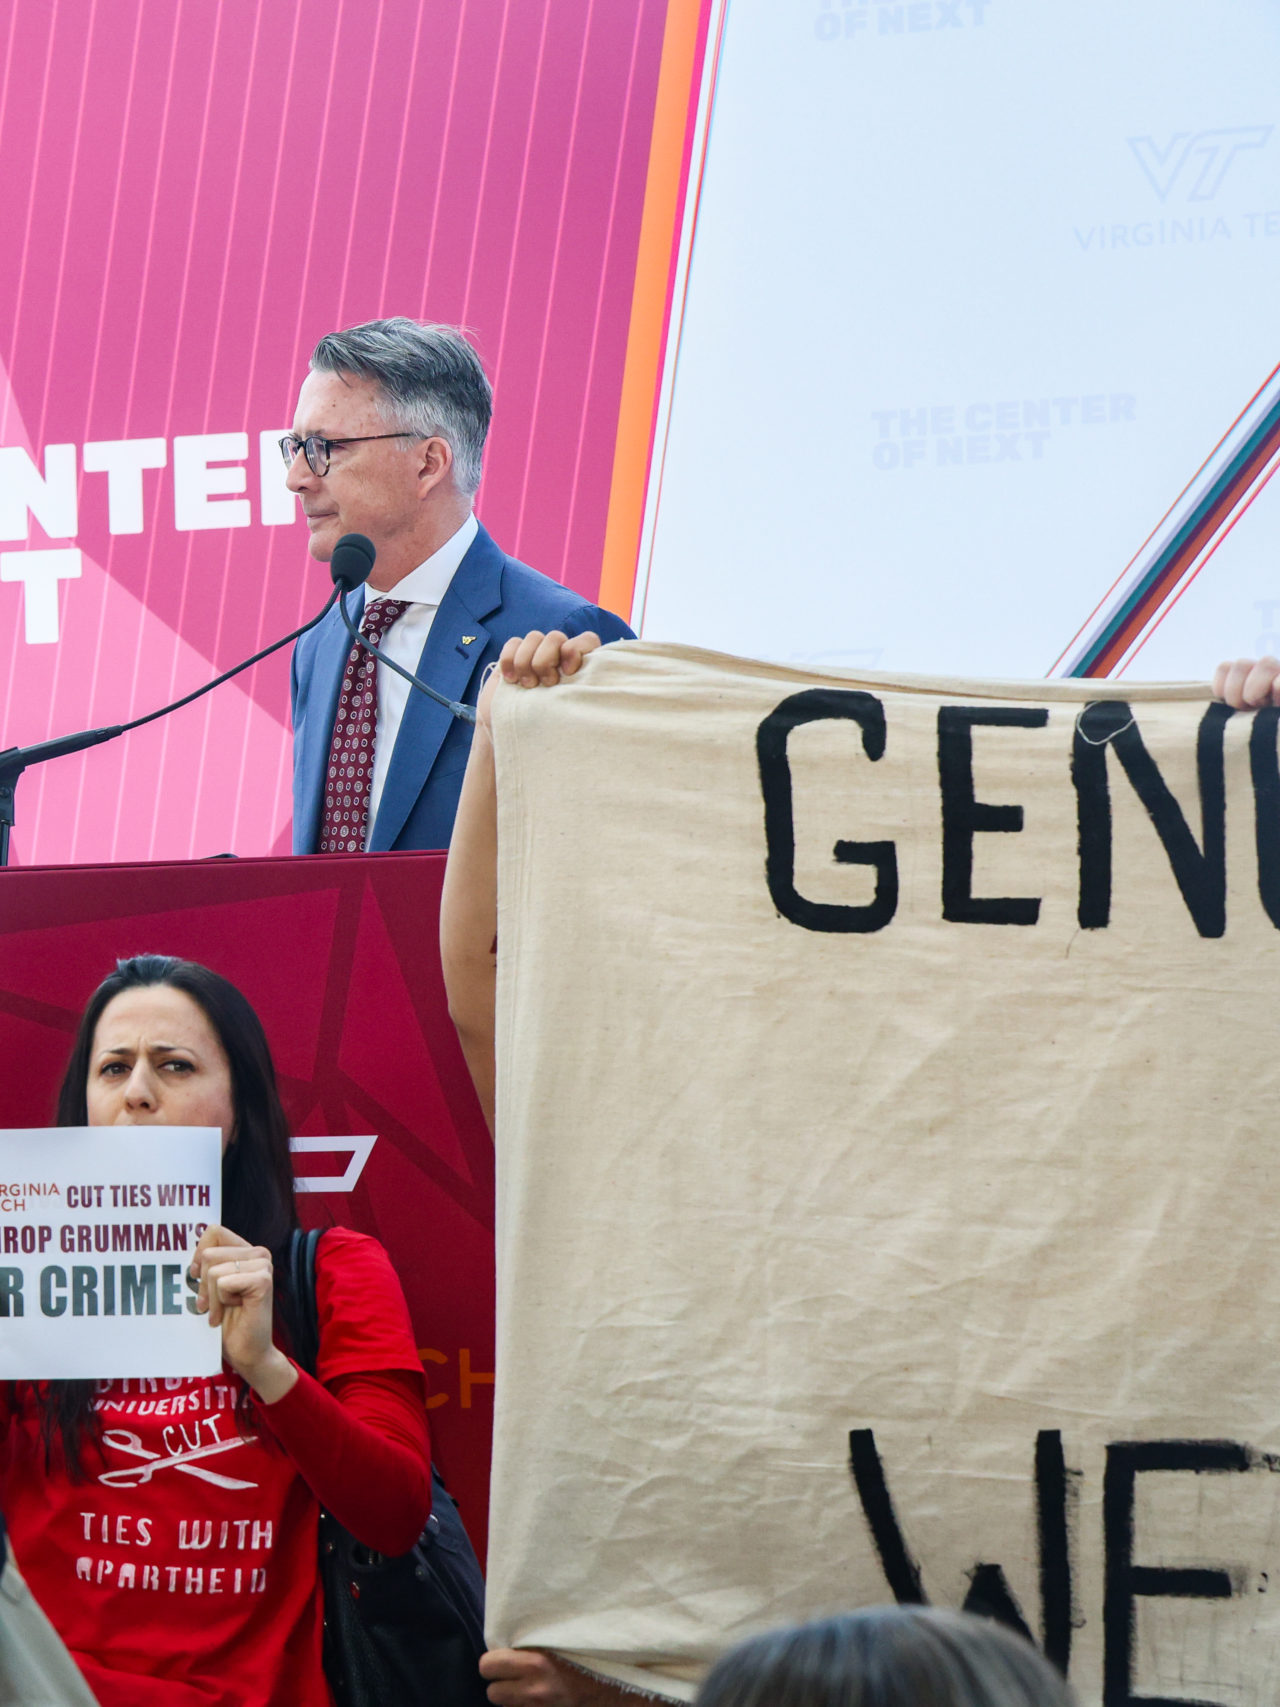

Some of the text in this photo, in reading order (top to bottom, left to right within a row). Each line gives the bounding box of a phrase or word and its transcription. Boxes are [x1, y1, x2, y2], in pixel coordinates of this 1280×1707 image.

[814, 0, 992, 40] OF NEXT
[1125, 124, 1275, 204] VT
[1072, 215, 1232, 251] VIRGINIA
[871, 393, 1137, 440] THE CENTER
[872, 431, 1051, 471] OF NEXT
[756, 688, 1280, 938] GEN
[66, 1184, 103, 1209] CUT
[109, 1184, 152, 1208] TIES
[158, 1184, 211, 1208] WITH
[162, 1413, 221, 1457] CUT
[80, 1512, 273, 1550] TIES WITH
[75, 1556, 267, 1594] APARTHEID
